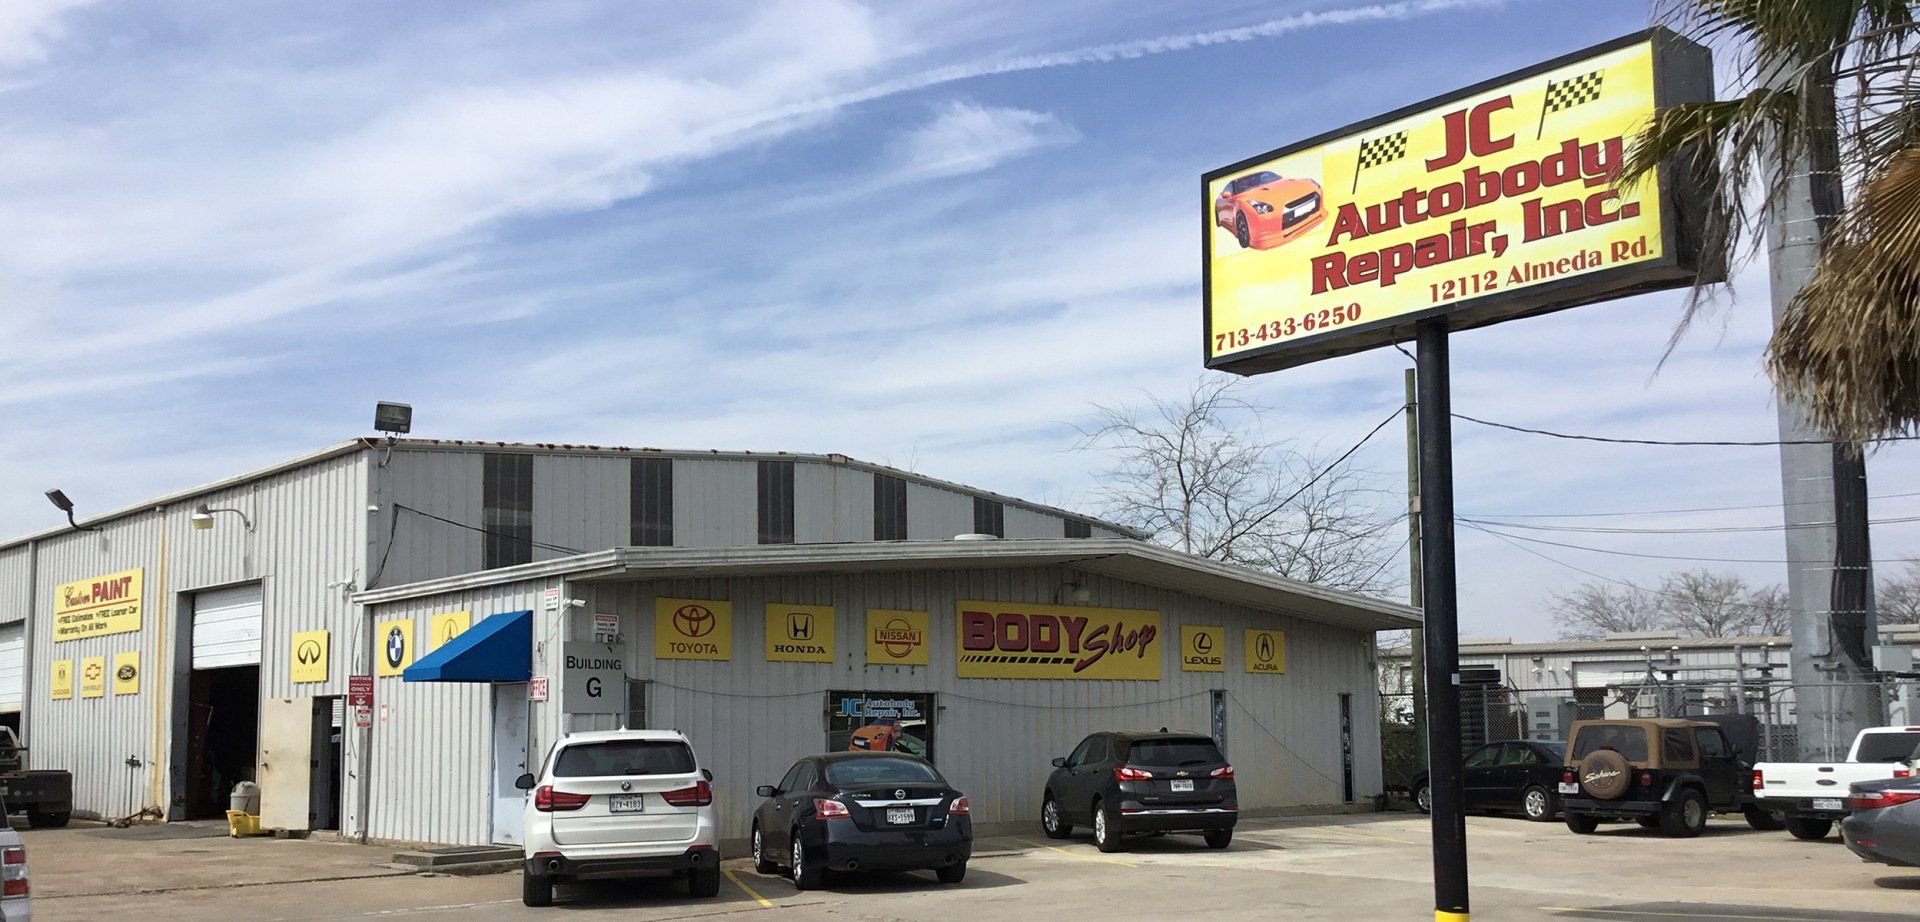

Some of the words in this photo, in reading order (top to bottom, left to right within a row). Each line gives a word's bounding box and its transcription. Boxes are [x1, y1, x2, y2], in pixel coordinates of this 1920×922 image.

[1425, 95, 1516, 172] JC
[1325, 135, 1625, 247] Autobody
[1310, 217, 1509, 296] Repair,
[1522, 188, 1641, 244] Inc.
[1429, 270, 1498, 303] 12112
[1506, 248, 1602, 286] Almeda
[1611, 236, 1656, 264] Rd.
[1215, 302, 1362, 352] 713-433-6250
[92, 576, 132, 603] PAINT
[879, 630, 917, 642] NISSAN
[962, 611, 1088, 654] BODY
[1073, 621, 1157, 674] Shop
[669, 642, 719, 655] TOYOTA
[774, 644, 826, 654] HONDA
[566, 656, 622, 670] BUILDING
[1184, 655, 1222, 665] LEXUS
[1253, 663, 1279, 672] ACURA
[586, 676, 602, 698] G
[836, 698, 863, 717] JC
[865, 698, 915, 709] Autobody
